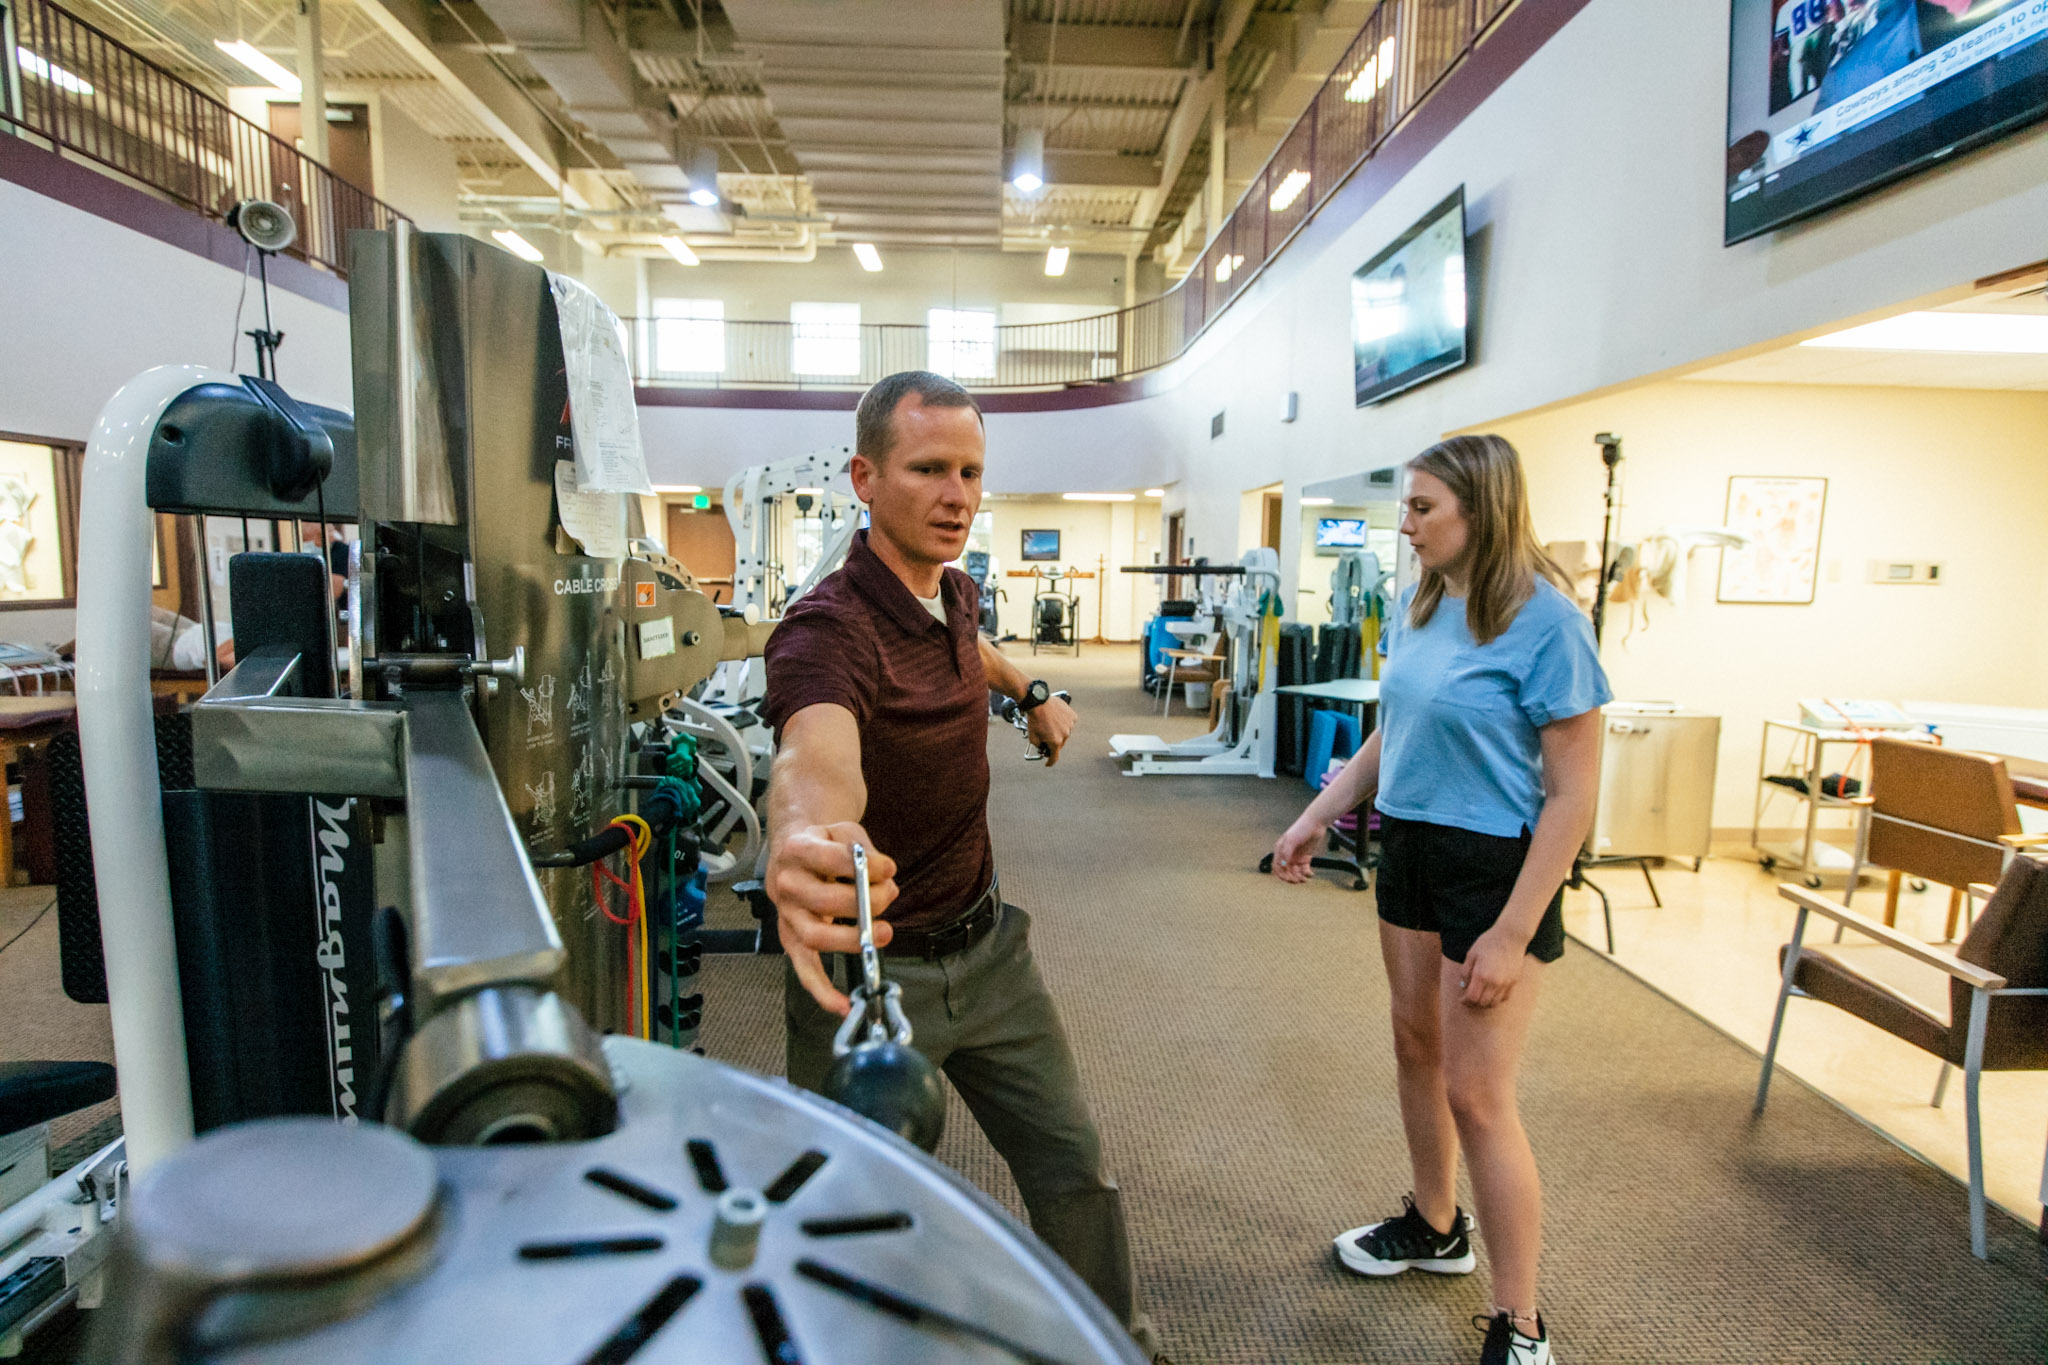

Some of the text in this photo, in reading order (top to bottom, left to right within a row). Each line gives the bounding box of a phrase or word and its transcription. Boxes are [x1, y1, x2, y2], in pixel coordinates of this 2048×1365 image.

[1836, 84, 1889, 117] Cowboys
[1893, 59, 1937, 89] among
[1941, 46, 1957, 63] 30
[1961, 22, 2006, 54] teams
[2011, 12, 2026, 26] to
[554, 577, 618, 595] CABLE CROSS
[674, 849, 686, 861] 10
